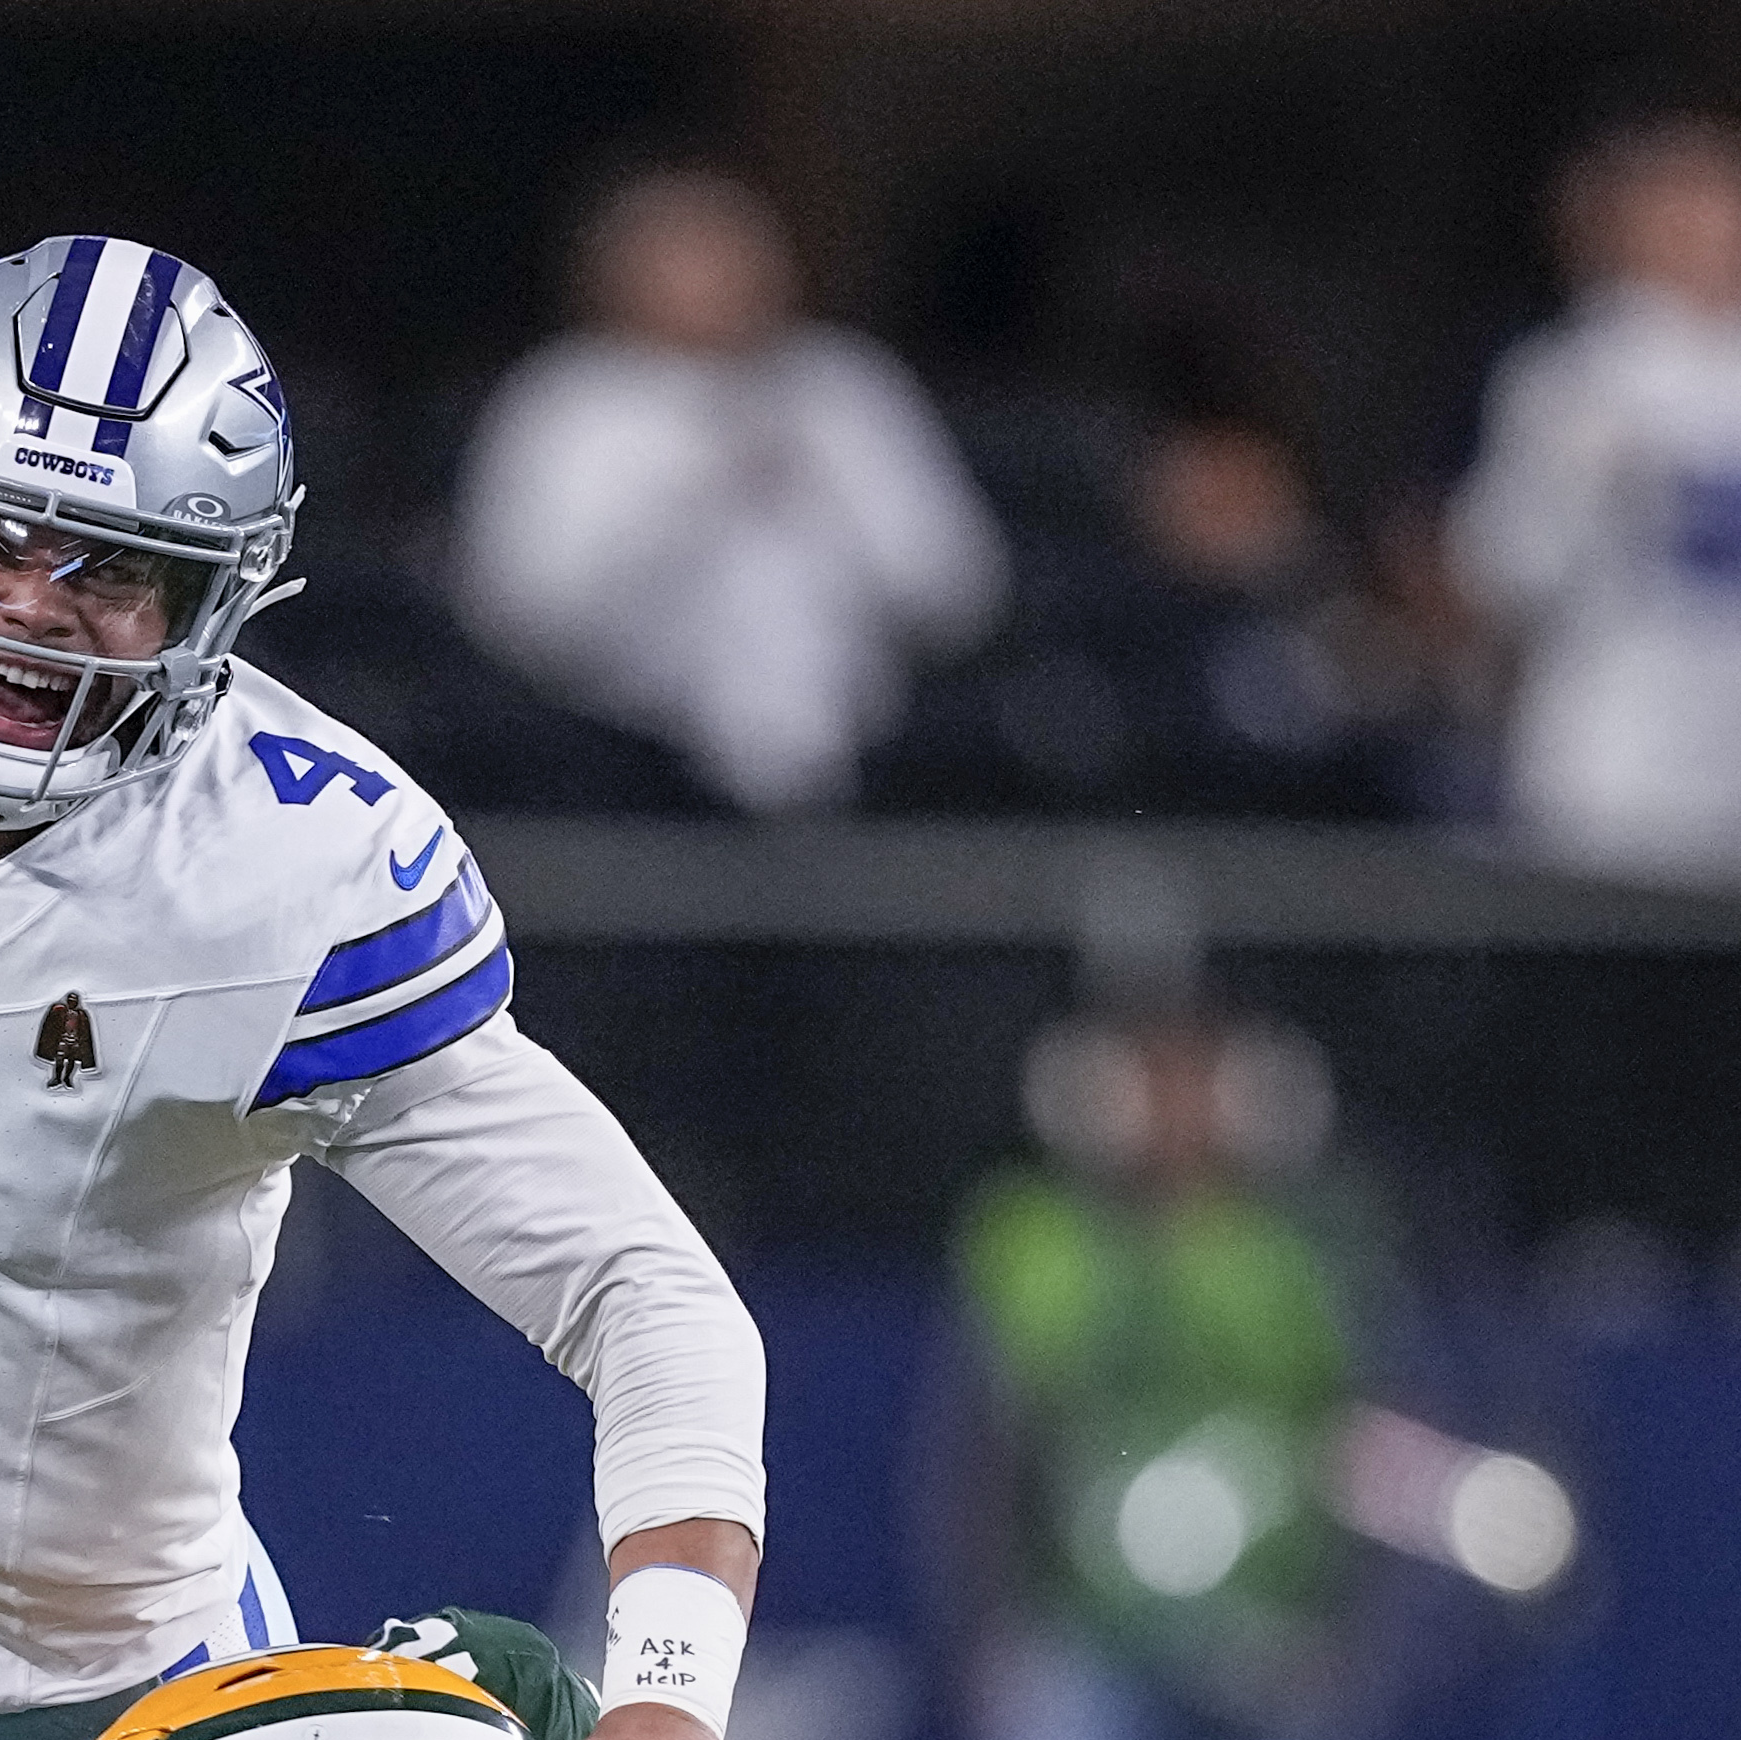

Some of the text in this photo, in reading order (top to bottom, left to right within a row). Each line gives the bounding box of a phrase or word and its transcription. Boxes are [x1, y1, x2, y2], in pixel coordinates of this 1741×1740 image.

[14, 447, 115, 486] COWBOYS
[248, 730, 399, 807] 4
[639, 1637, 696, 1656] ASK
[654, 1656, 674, 1671] 4
